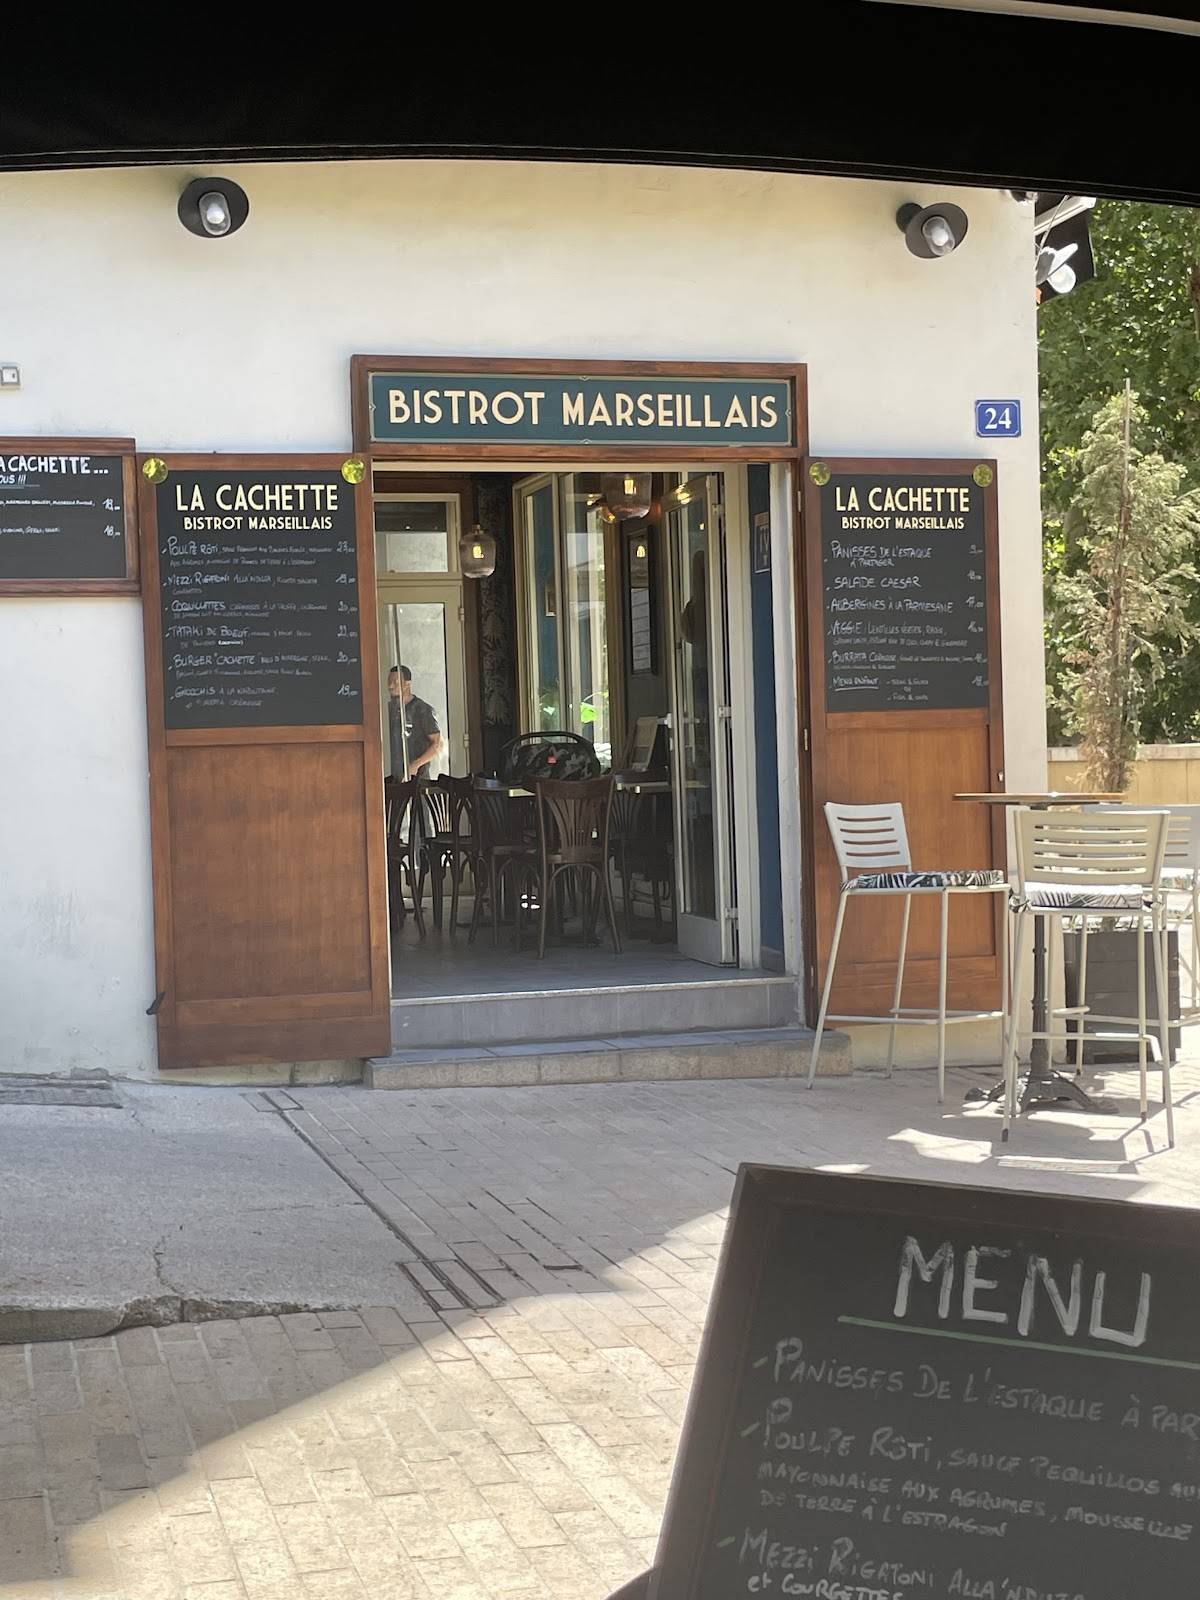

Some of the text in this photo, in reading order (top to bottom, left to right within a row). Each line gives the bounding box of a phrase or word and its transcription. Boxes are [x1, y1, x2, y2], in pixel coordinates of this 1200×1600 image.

[388, 389, 779, 429] BISTROT MARSEILLAIS
[984, 407, 1012, 430] 24
[0, 455, 6, 473] A
[0, 474, 16, 485] OUS
[175, 484, 339, 511] LA CACHETTE
[835, 486, 970, 512] LA CACHETTE
[183, 516, 333, 531] BISTROT MARSEILLAIS
[841, 516, 965, 530] BISTROT MARSEILLAIS
[834, 575, 922, 590] SALADE CAESAR
[894, 1235, 1152, 1347] MENU
[912, 1364, 952, 1400] DE
[962, 1366, 1105, 1421] L'ESTAQUE
[1120, 1393, 1141, 1428] À
[1151, 1404, 1200, 1441] PAR
[763, 1396, 856, 1457] POULPE
[948, 1447, 1023, 1473] SAUCE
[1170, 1481, 1200, 1501] AU
[901, 1479, 941, 1502] AUX
[794, 1493, 857, 1513] TERRE
[860, 1496, 878, 1521] À
